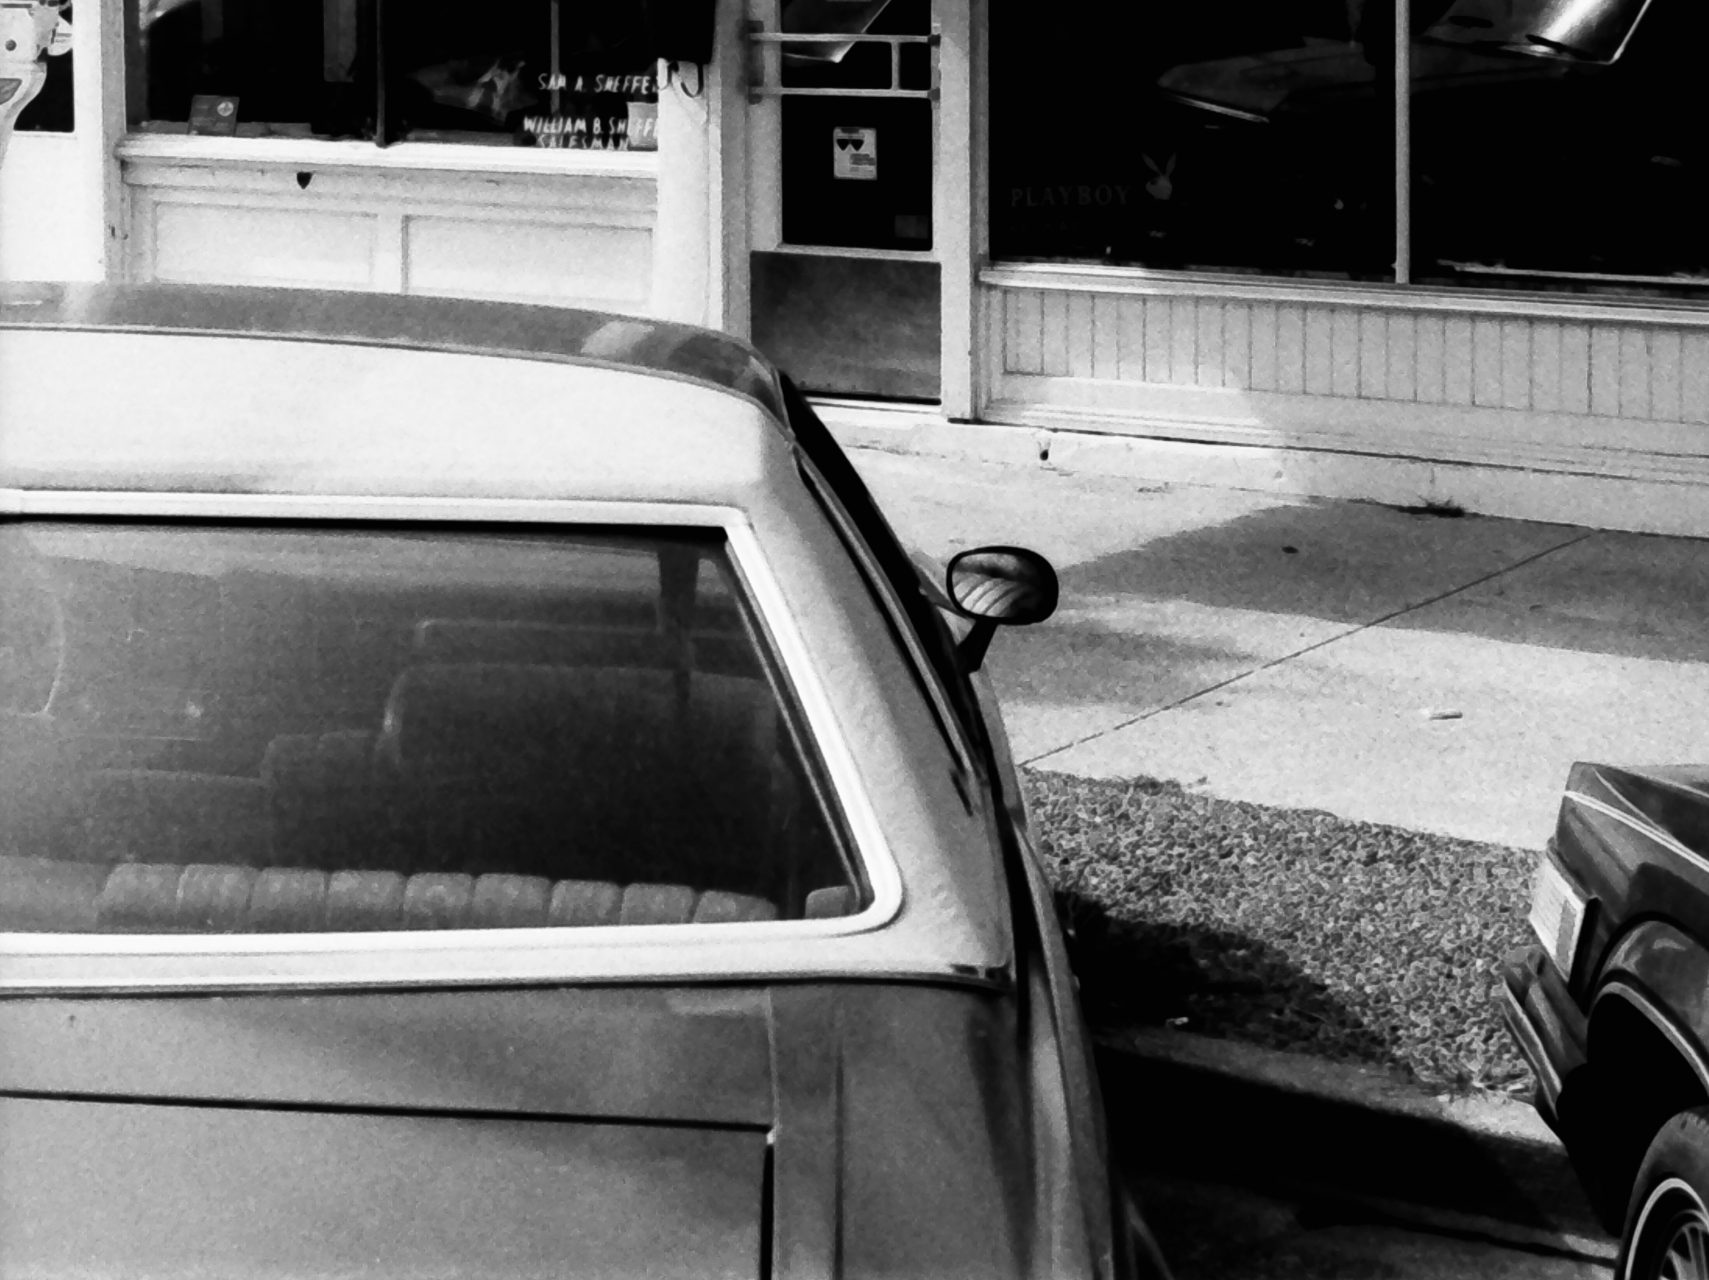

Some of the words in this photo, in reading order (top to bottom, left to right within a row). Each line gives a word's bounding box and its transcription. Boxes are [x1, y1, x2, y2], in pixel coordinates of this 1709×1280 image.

[537, 73, 566, 91] SAM
[594, 74, 659, 95] SHEFFE
[523, 115, 587, 134] WILLIAM
[1009, 183, 1132, 208] PLAYBOY
